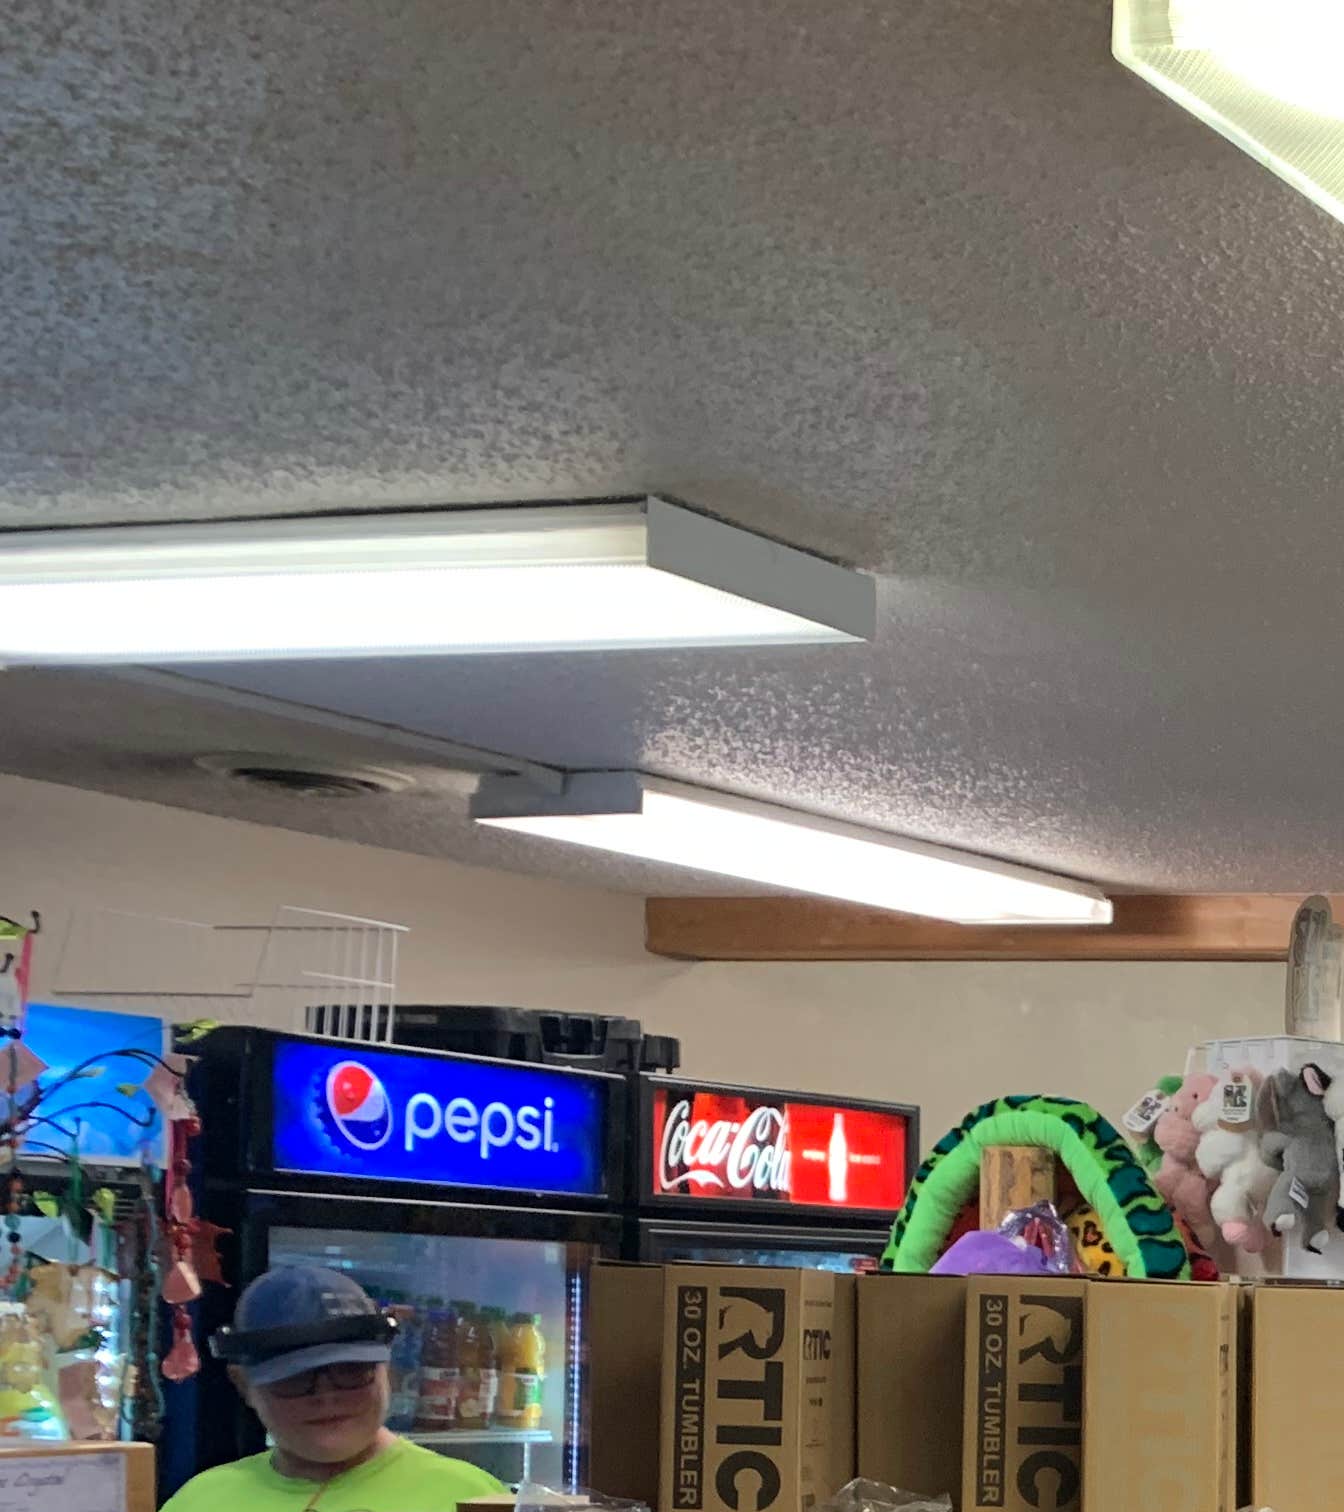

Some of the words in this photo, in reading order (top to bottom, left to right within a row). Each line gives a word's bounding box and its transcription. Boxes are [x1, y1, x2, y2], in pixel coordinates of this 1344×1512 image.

[404, 1092, 554, 1160] pepsi
[683, 1289, 702, 1318] 30
[986, 1299, 1003, 1326] 30
[678, 1378, 700, 1506] TUMBLER
[715, 1286, 786, 1512] RTIC
[982, 1382, 1002, 1504] TUMBLER
[1017, 1294, 1084, 1509] RTIC
